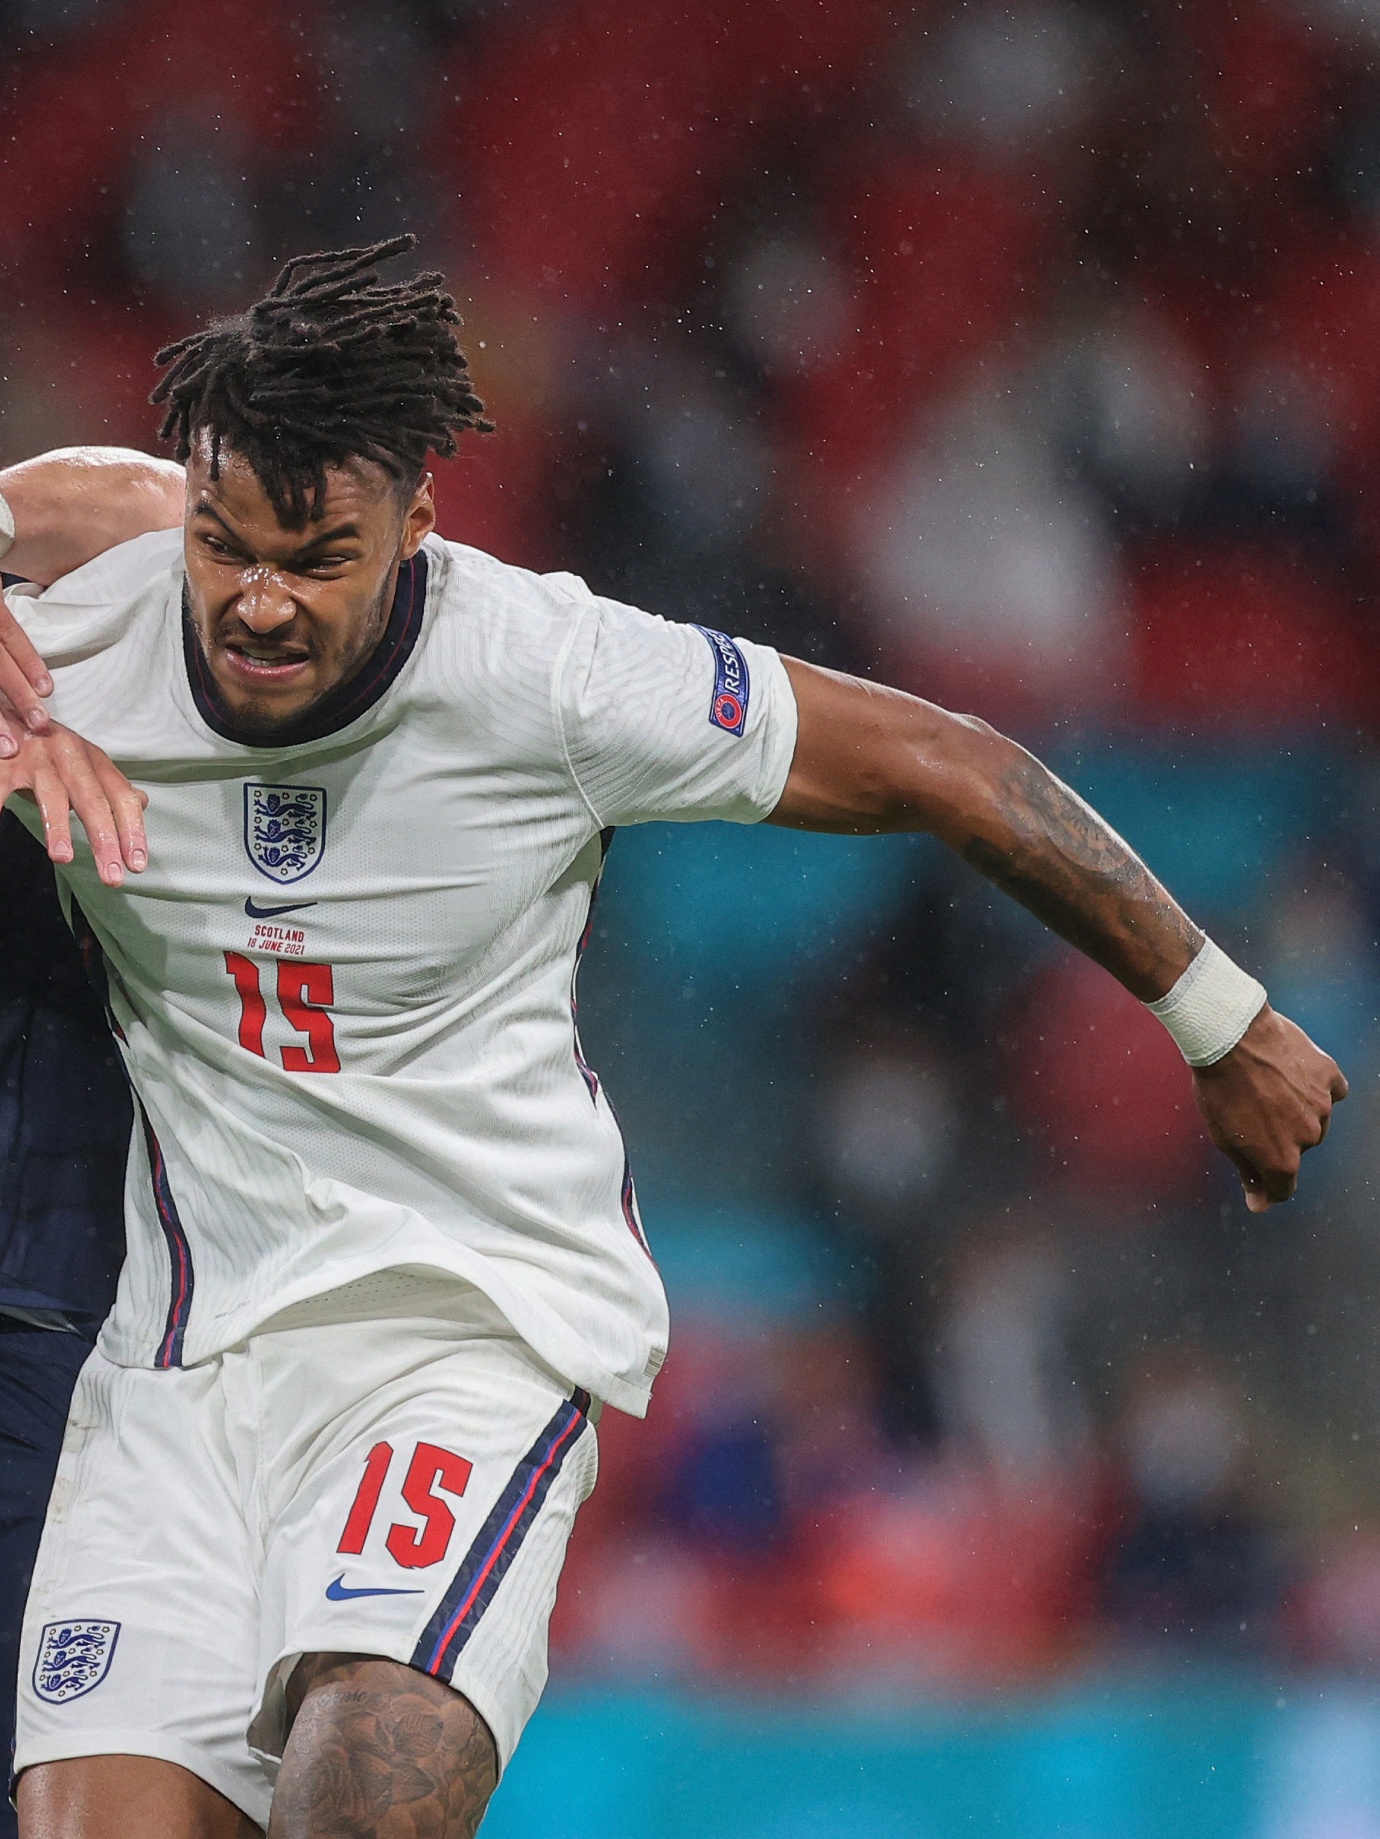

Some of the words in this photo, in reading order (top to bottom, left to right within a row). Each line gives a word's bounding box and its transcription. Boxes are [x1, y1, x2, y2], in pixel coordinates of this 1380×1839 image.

[247, 937, 257, 948] 18
[258, 939, 284, 952] JUNE
[284, 944, 305, 956] 2021
[254, 924, 305, 943] SCOTLAND
[223, 950, 342, 1074] 15
[336, 1440, 474, 1570] 15
